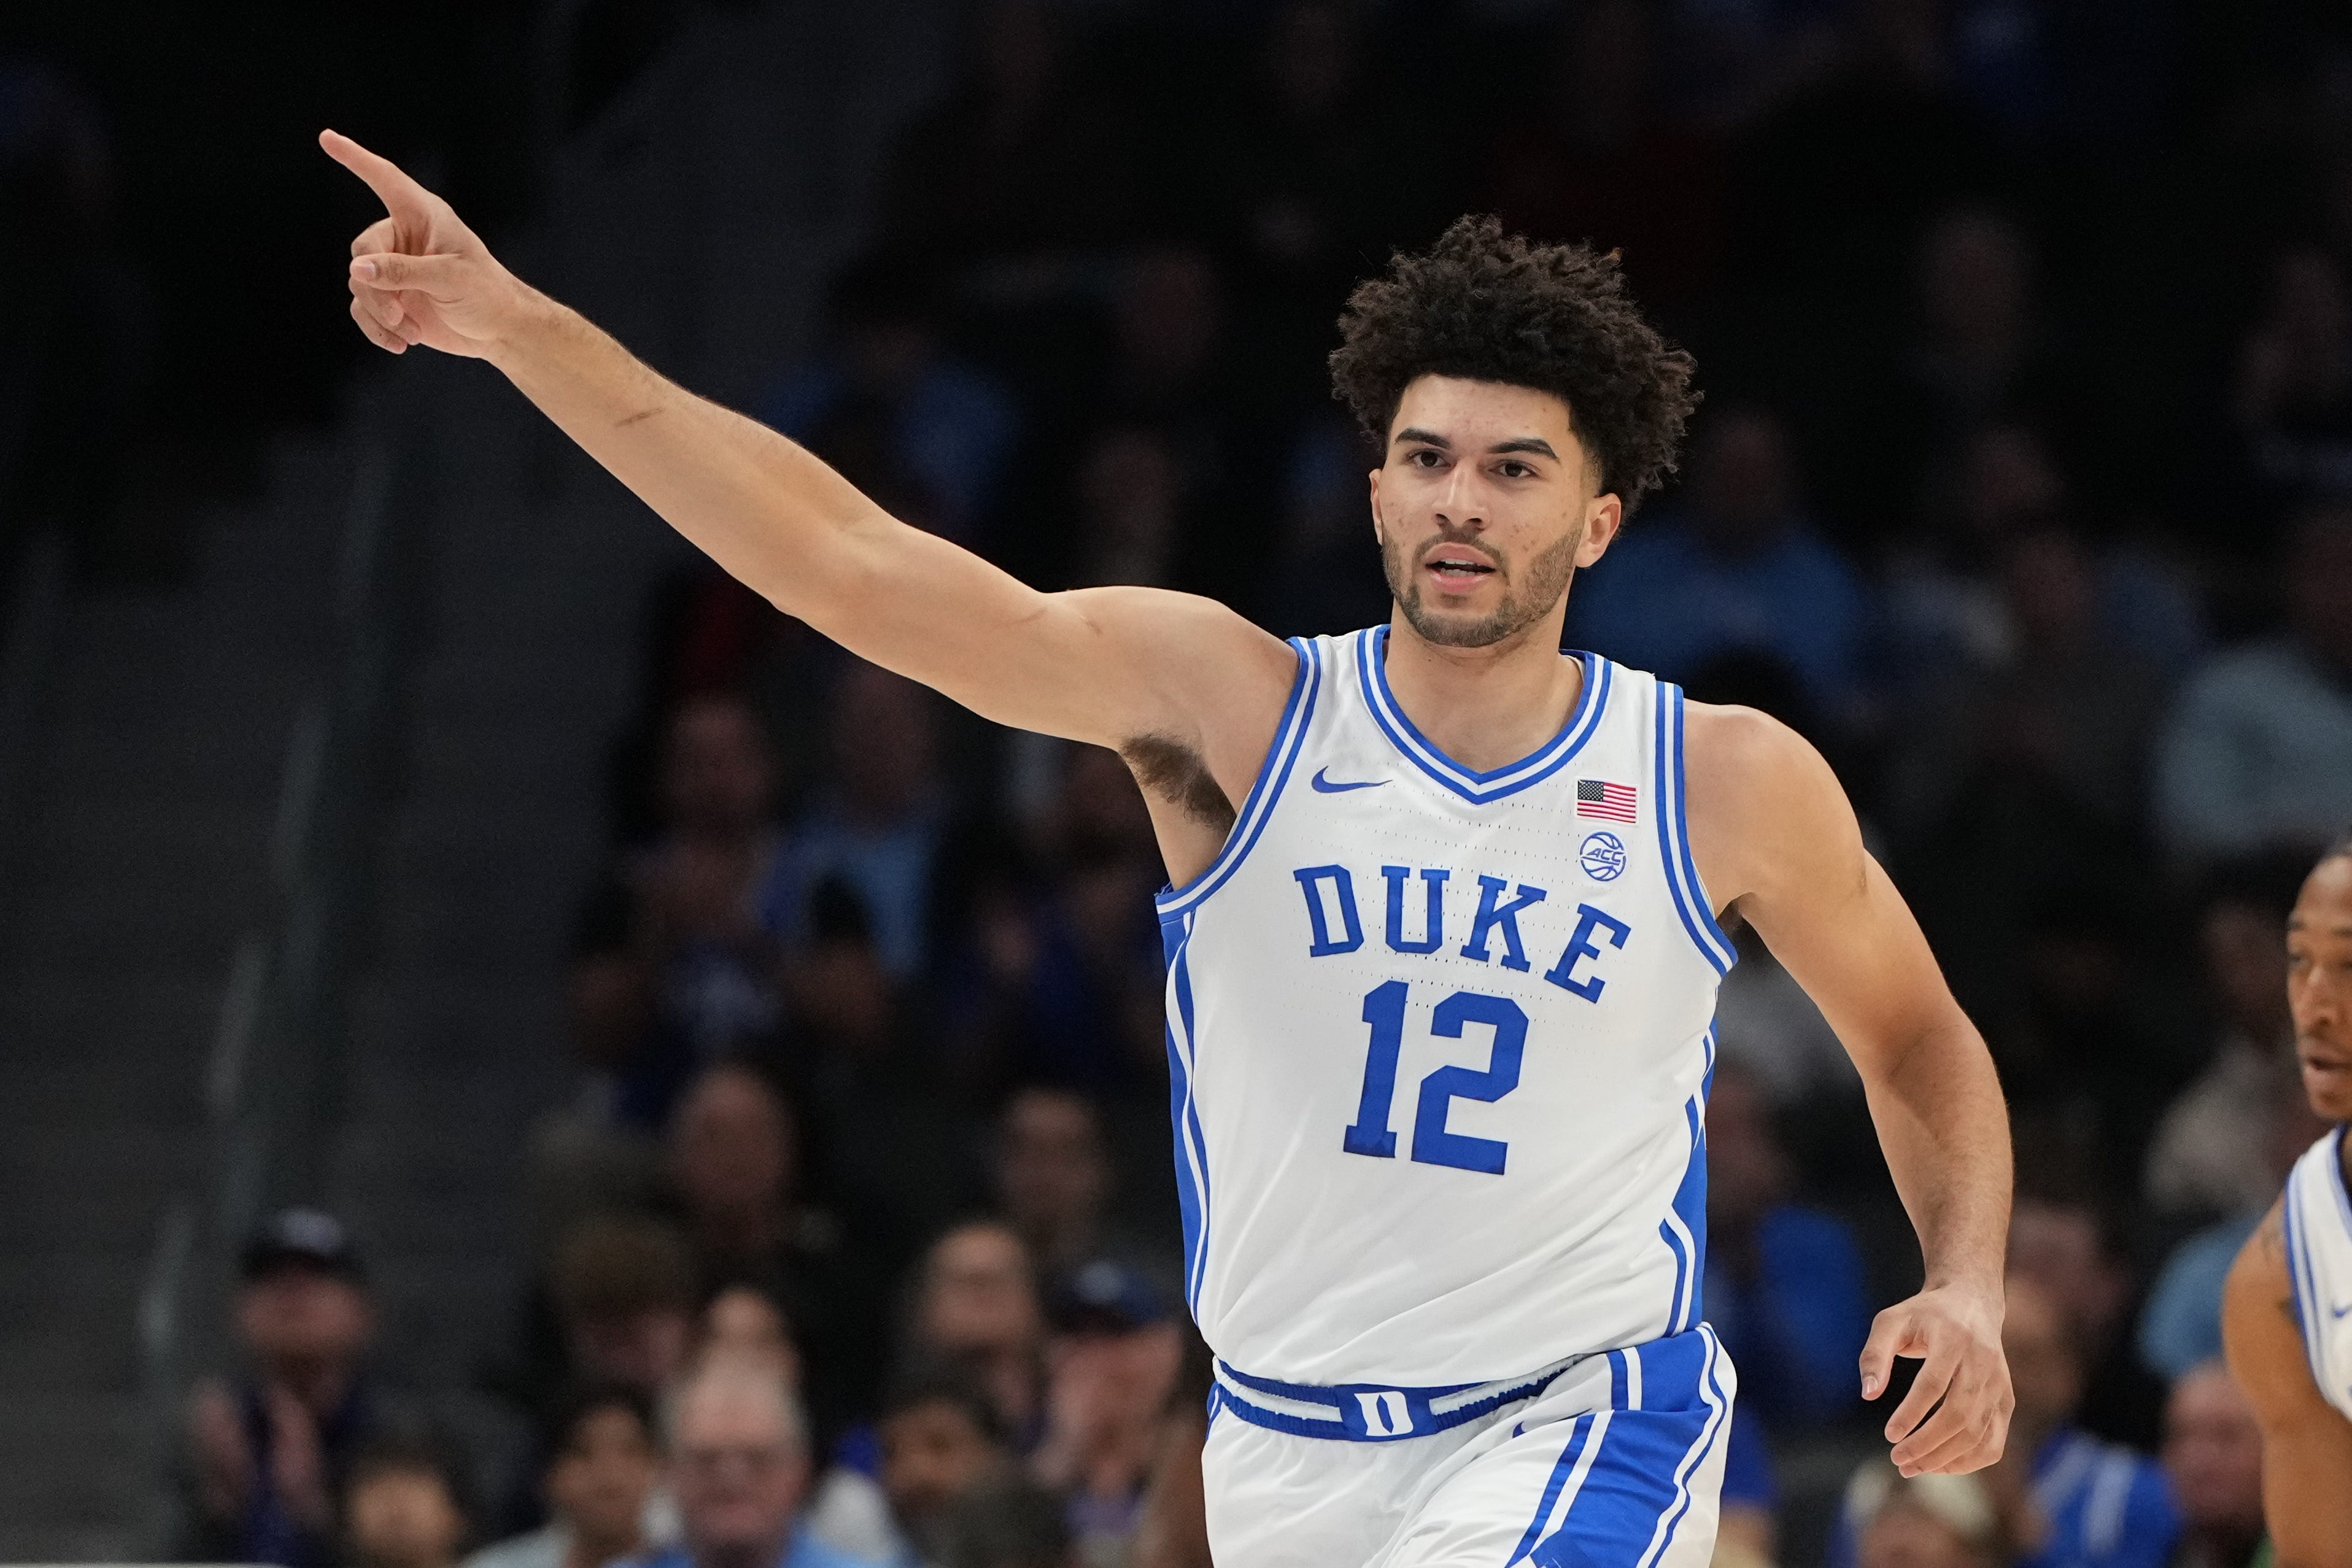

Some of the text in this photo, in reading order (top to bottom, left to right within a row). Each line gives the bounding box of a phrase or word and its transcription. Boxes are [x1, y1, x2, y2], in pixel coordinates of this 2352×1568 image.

[1586, 848, 1625, 863] ACC
[1293, 863, 1631, 1003] DUKE
[1343, 979, 1530, 1175] 12
[1354, 1391, 1414, 1437] D
